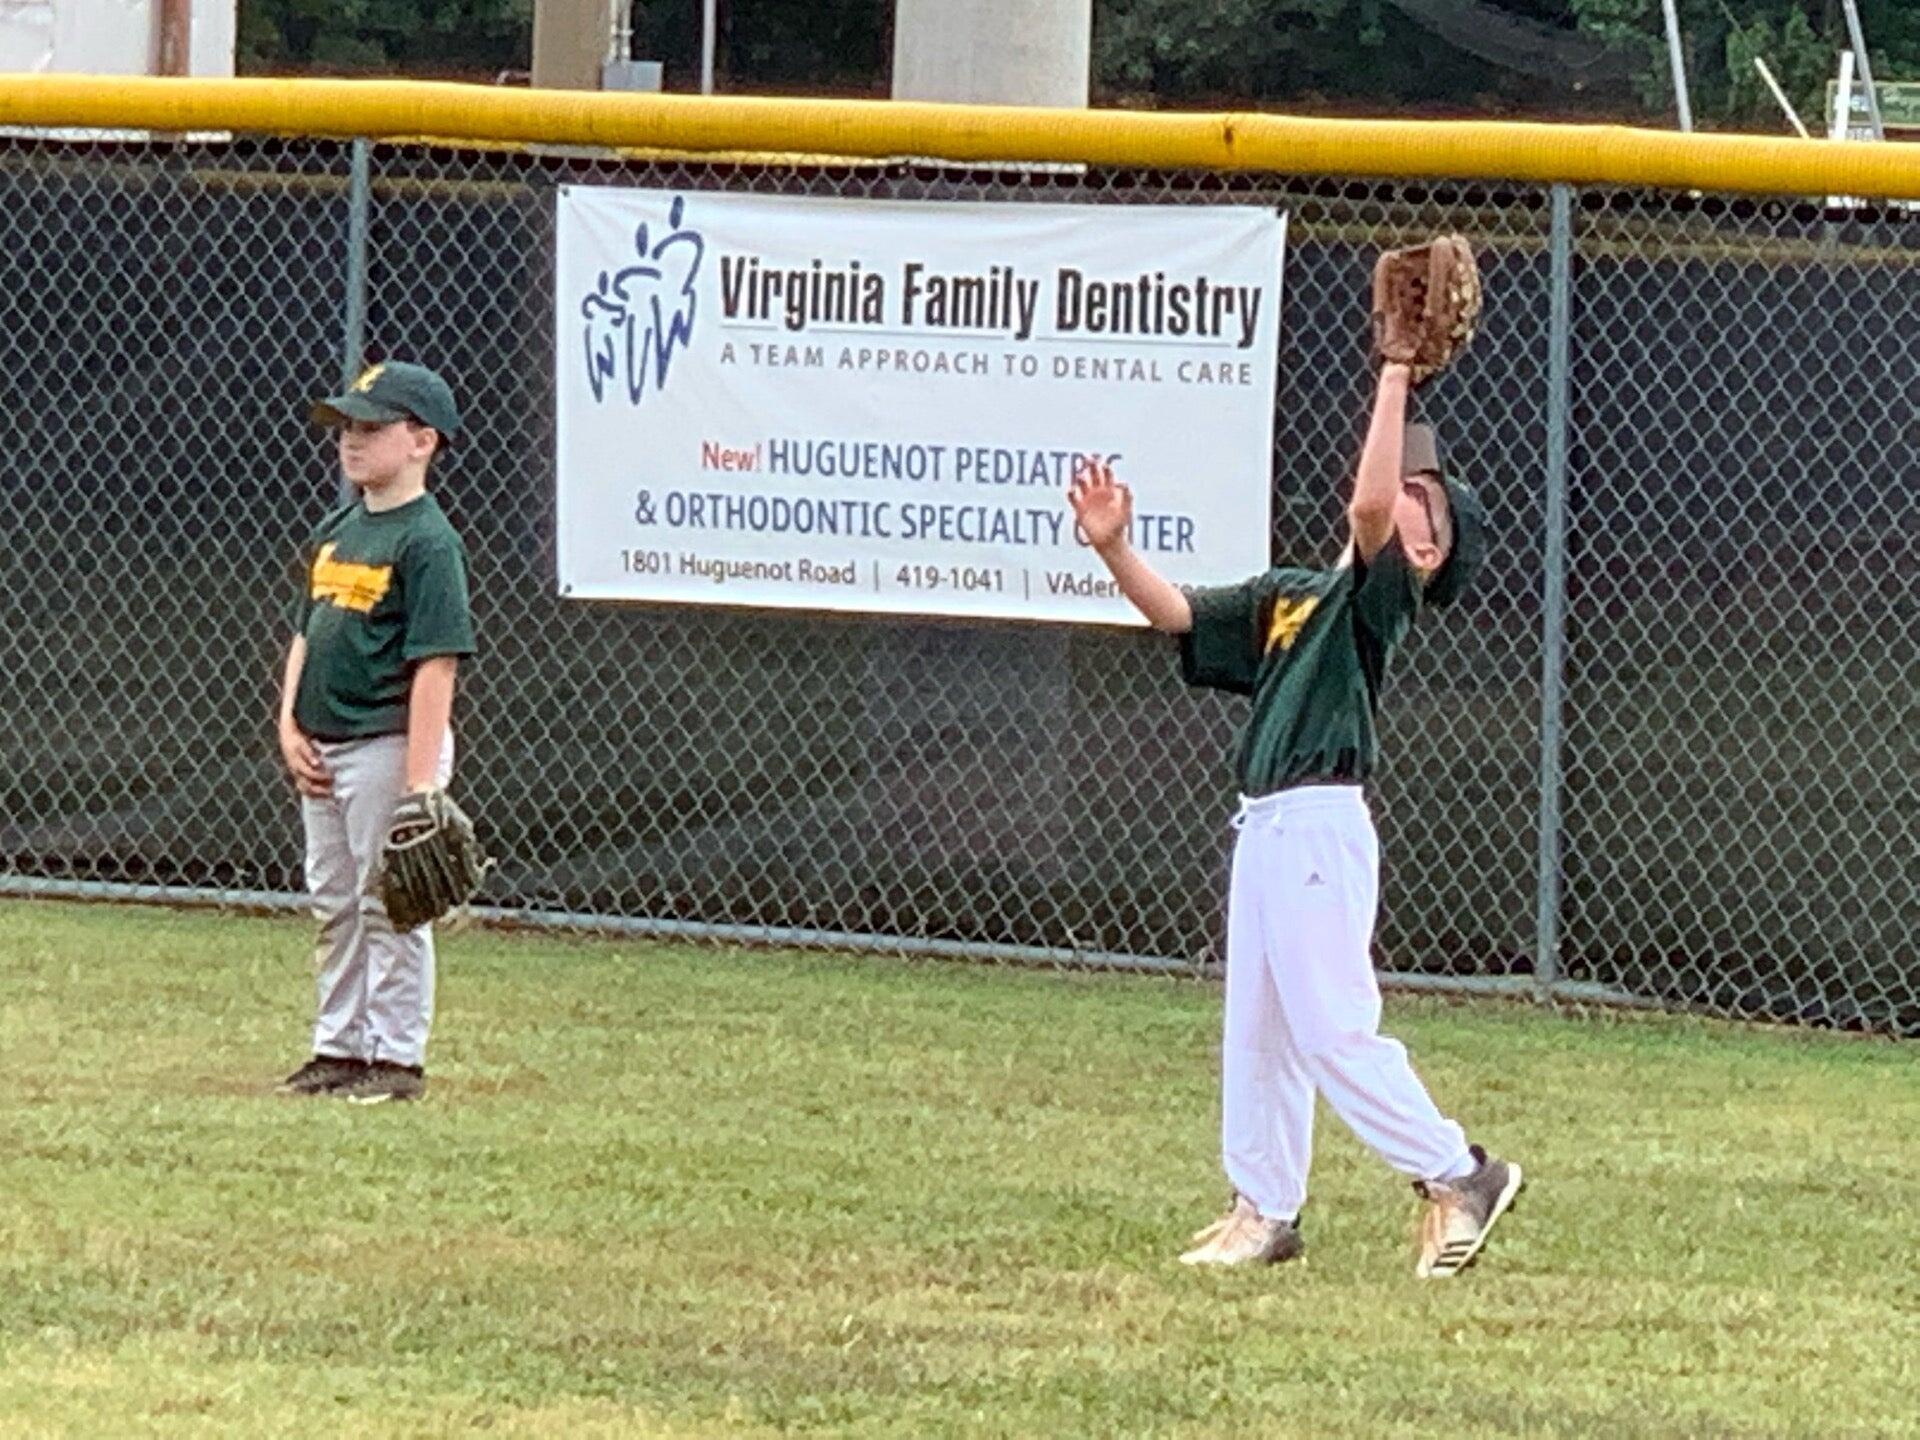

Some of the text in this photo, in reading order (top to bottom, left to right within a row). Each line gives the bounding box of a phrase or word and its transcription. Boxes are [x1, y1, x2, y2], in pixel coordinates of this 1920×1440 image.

[721, 256, 1262, 349] Virginia Family Dentistry
[721, 343, 1251, 385] A TEAM APPROACH TO DENTAL CARE
[702, 438, 1123, 486] New! HUGUENOT PEDIATR
[635, 490, 658, 526] &
[665, 491, 892, 539] ORTHODONTIC
[900, 503, 1064, 546] SPECIALTY
[621, 550, 671, 576] 1801
[679, 553, 794, 585] Huguenot
[798, 558, 856, 585] Road
[896, 564, 1003, 593] 419-1041
